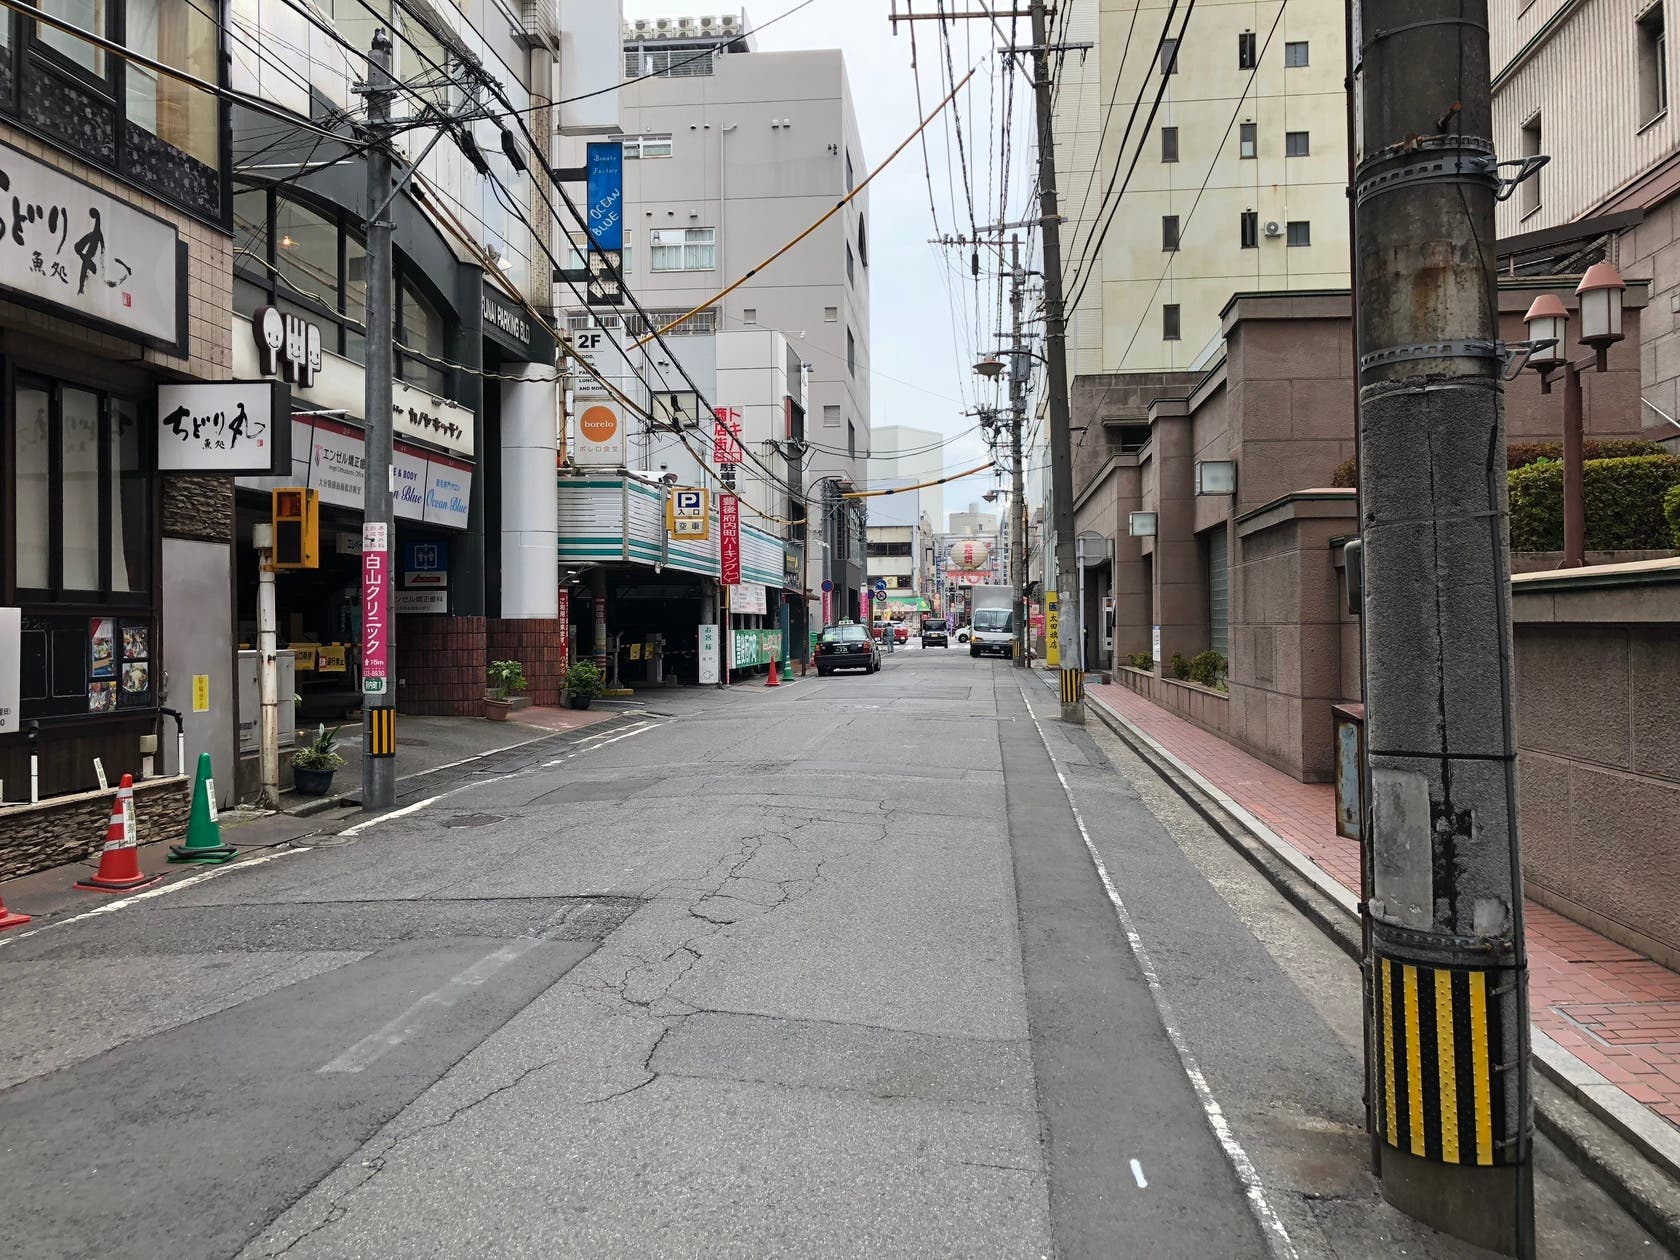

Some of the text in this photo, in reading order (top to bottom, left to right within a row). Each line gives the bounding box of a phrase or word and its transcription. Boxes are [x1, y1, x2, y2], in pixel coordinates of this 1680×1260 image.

[590, 188, 620, 219] OCEAN
[592, 211, 619, 236] BLUE
[497, 305, 519, 338] PARKING
[578, 334, 601, 349] 2F
[584, 420, 614, 428] borelo
[729, 407, 742, 452] トキハ
[323, 448, 367, 470] エンゼル矯正歯
[579, 445, 618, 453] ボレロ食堂
[403, 469, 418, 480] BODY
[401, 485, 423, 504] Blue
[425, 488, 468, 514] Ocean Blue
[681, 494, 697, 508] P
[679, 522, 700, 531] 空車
[365, 553, 382, 655] 白山クリニック
